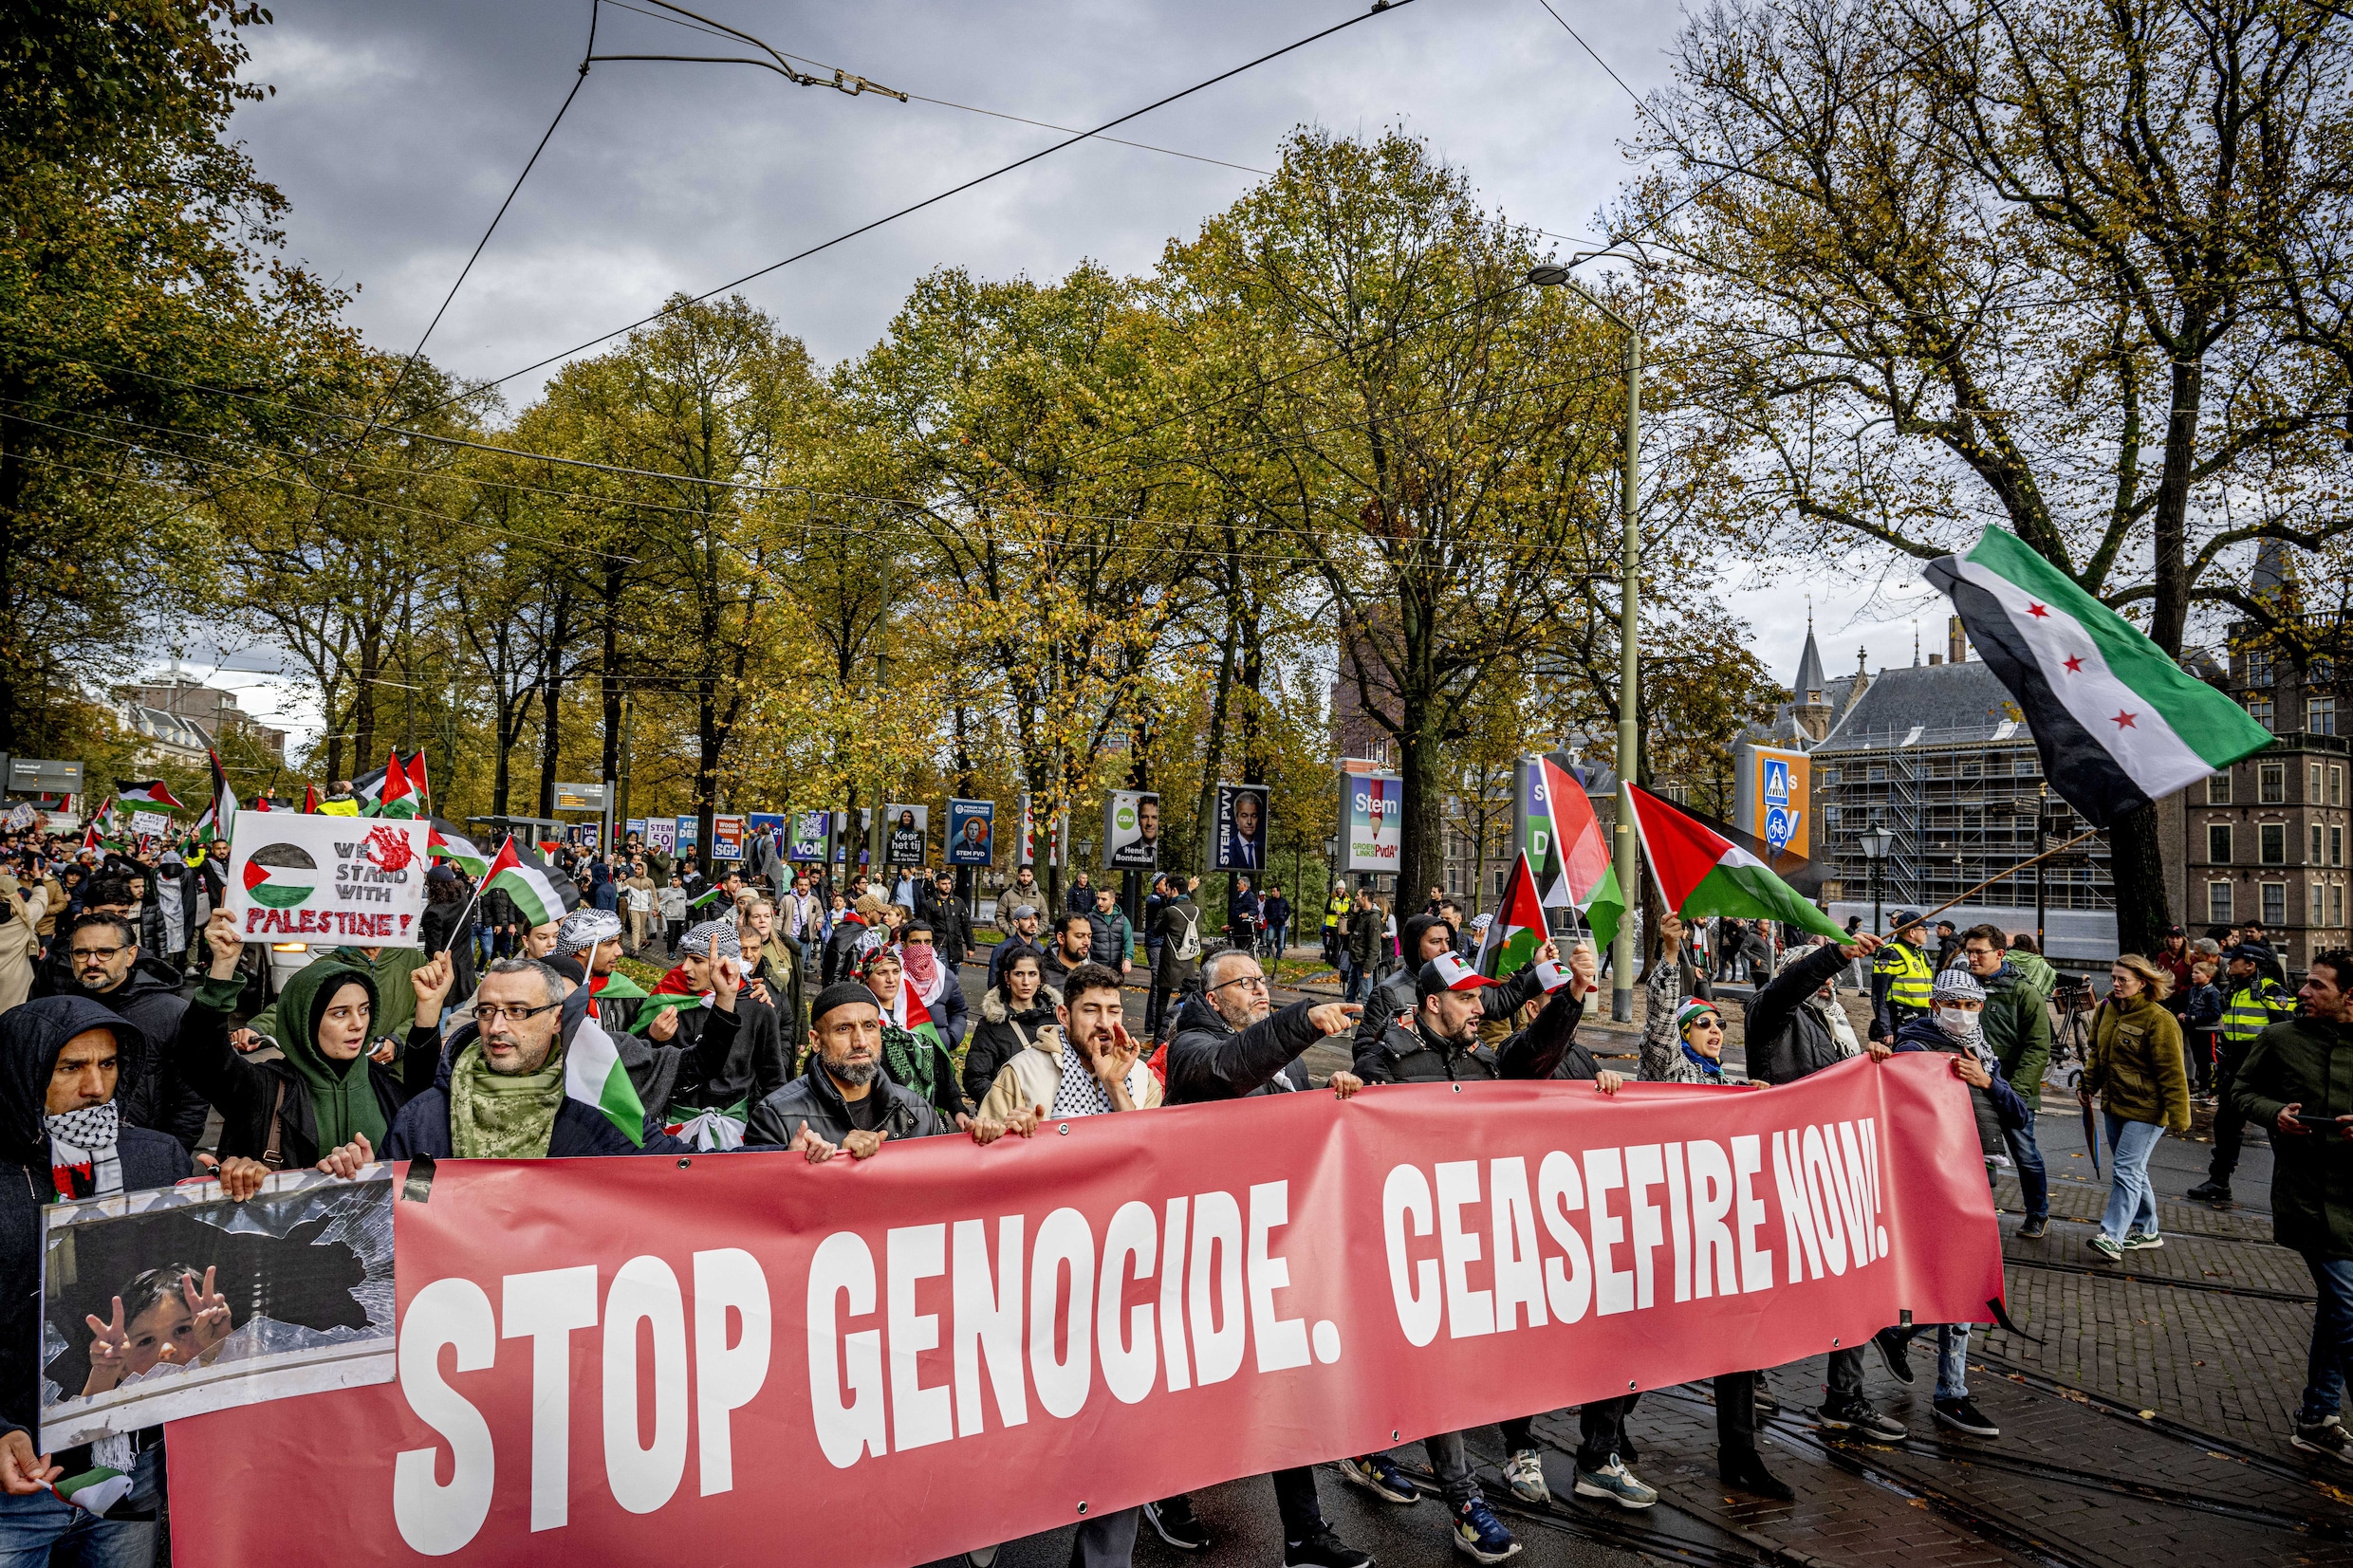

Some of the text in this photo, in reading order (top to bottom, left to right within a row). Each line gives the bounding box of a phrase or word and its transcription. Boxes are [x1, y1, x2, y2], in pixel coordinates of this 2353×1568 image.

[1355, 792, 1398, 814] Stem
[1118, 815, 1134, 823] CDA
[1219, 789, 1232, 865] STEM PVV
[895, 830, 918, 840] Keer
[334, 842, 370, 858] WE
[714, 843, 739, 856] SGP
[795, 840, 824, 855] Volt
[892, 839, 920, 852] het tij
[1116, 854, 1153, 862] Bontenbal
[336, 863, 408, 883] STAND
[335, 884, 391, 902] WITH
[394, 1117, 1889, 1556] STOP GENOCIDE. CEASEFIRE NOW!
